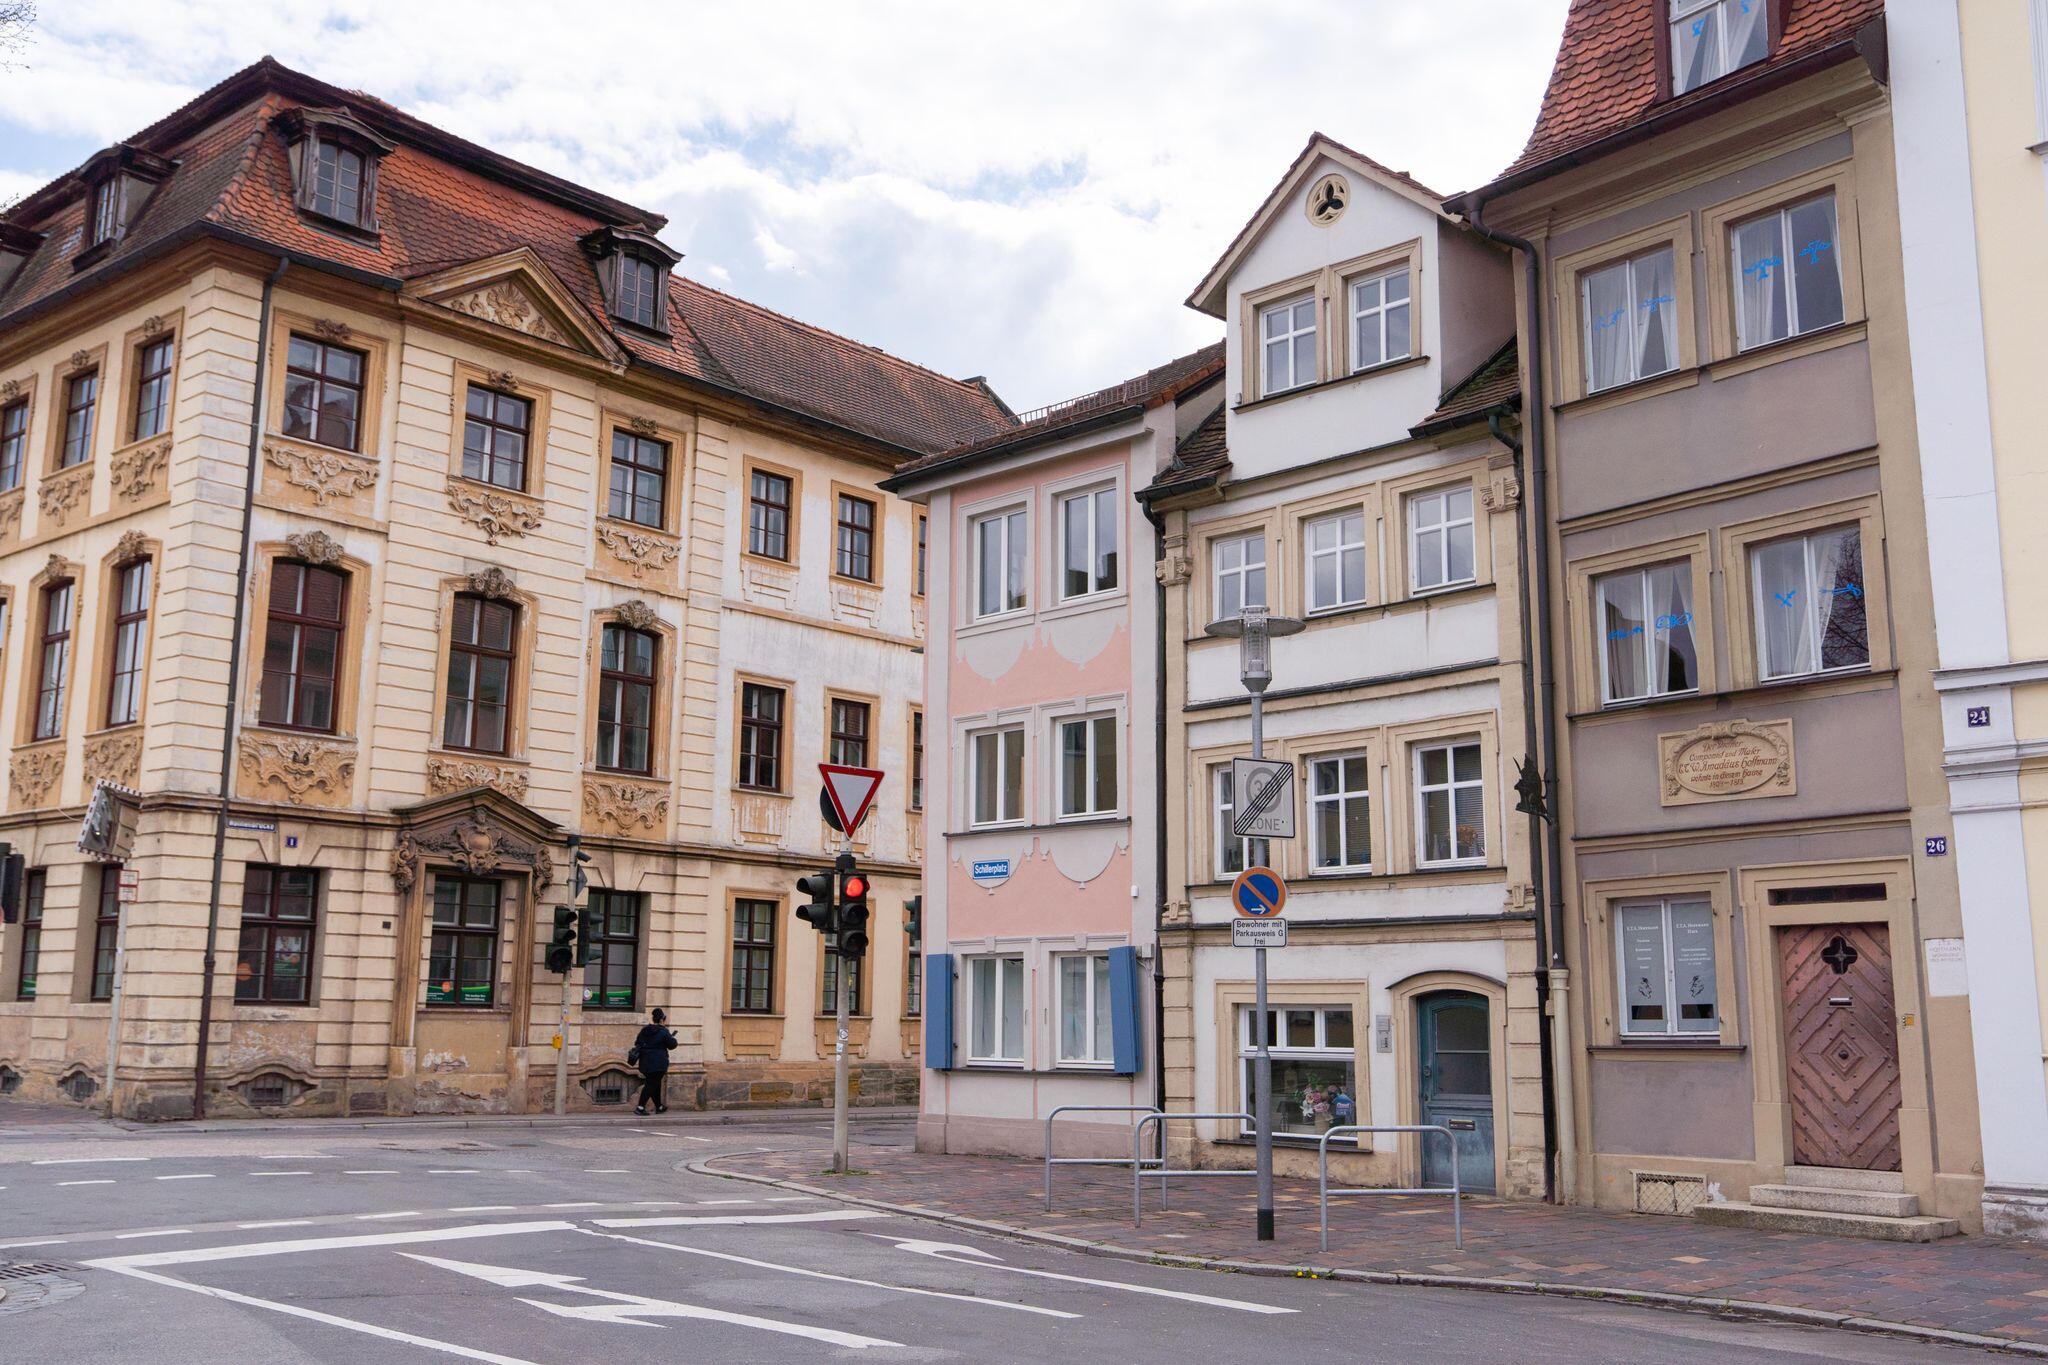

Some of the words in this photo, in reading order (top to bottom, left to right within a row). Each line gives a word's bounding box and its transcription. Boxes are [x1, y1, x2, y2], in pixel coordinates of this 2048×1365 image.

[1969, 710, 1987, 724] 24
[1740, 756, 1778, 769] Hoffmann
[1927, 840, 1945, 853] 26
[974, 863, 1007, 875] Schillerplatz
[1236, 920, 1269, 928] Bewohner
[1271, 920, 1282, 928] mit
[1278, 929, 1284, 937] G
